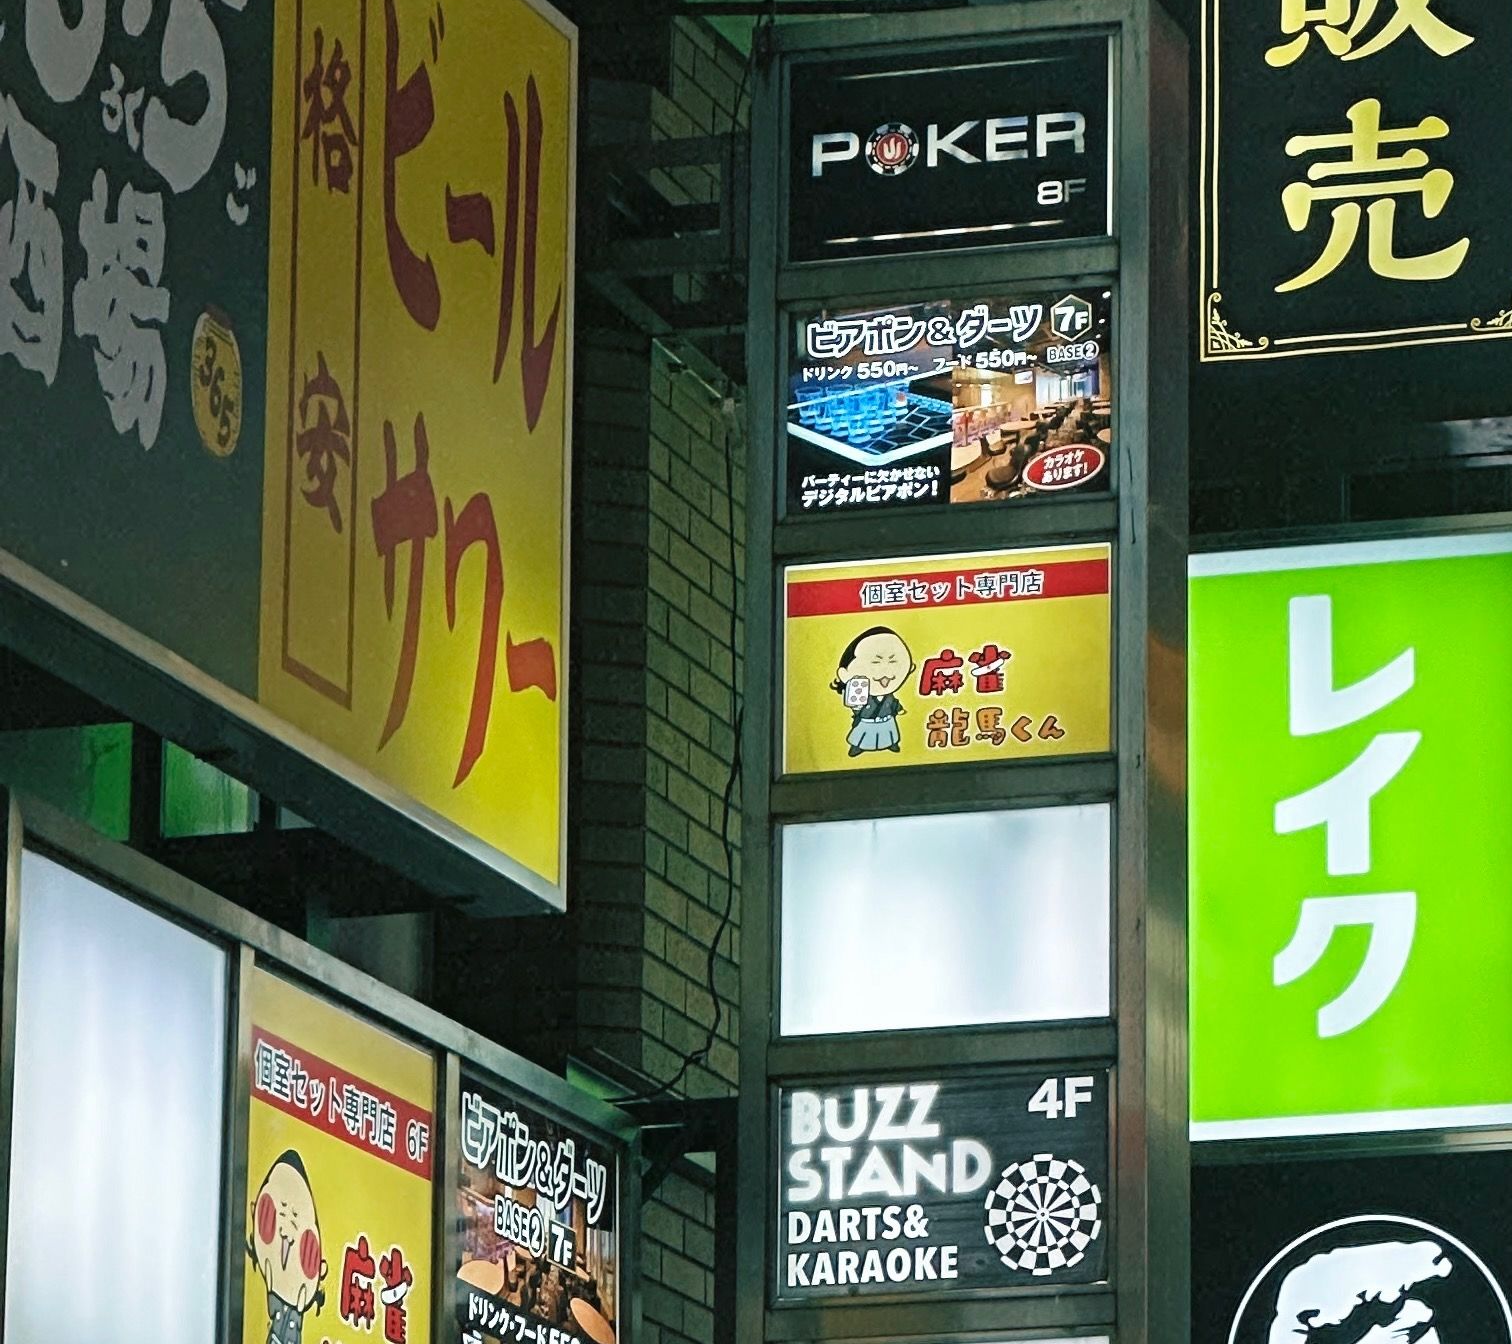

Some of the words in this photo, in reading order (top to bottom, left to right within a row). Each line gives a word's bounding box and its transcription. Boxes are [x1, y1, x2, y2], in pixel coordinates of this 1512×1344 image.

[1036, 177, 1087, 206] 8F
[1054, 306, 1090, 333] 7F
[371, 411, 558, 790] サワー
[859, 570, 1044, 607] 個室セット専門店
[918, 643, 1012, 697] 麻雀
[924, 706, 1067, 749] 龍馬くん
[1272, 594, 1422, 1040] レイク
[790, 1082, 942, 1147] BUZZ
[1026, 1076, 1095, 1120] 4F
[787, 1138, 994, 1204] STAND
[786, 1245, 959, 1287] KARAOKE
